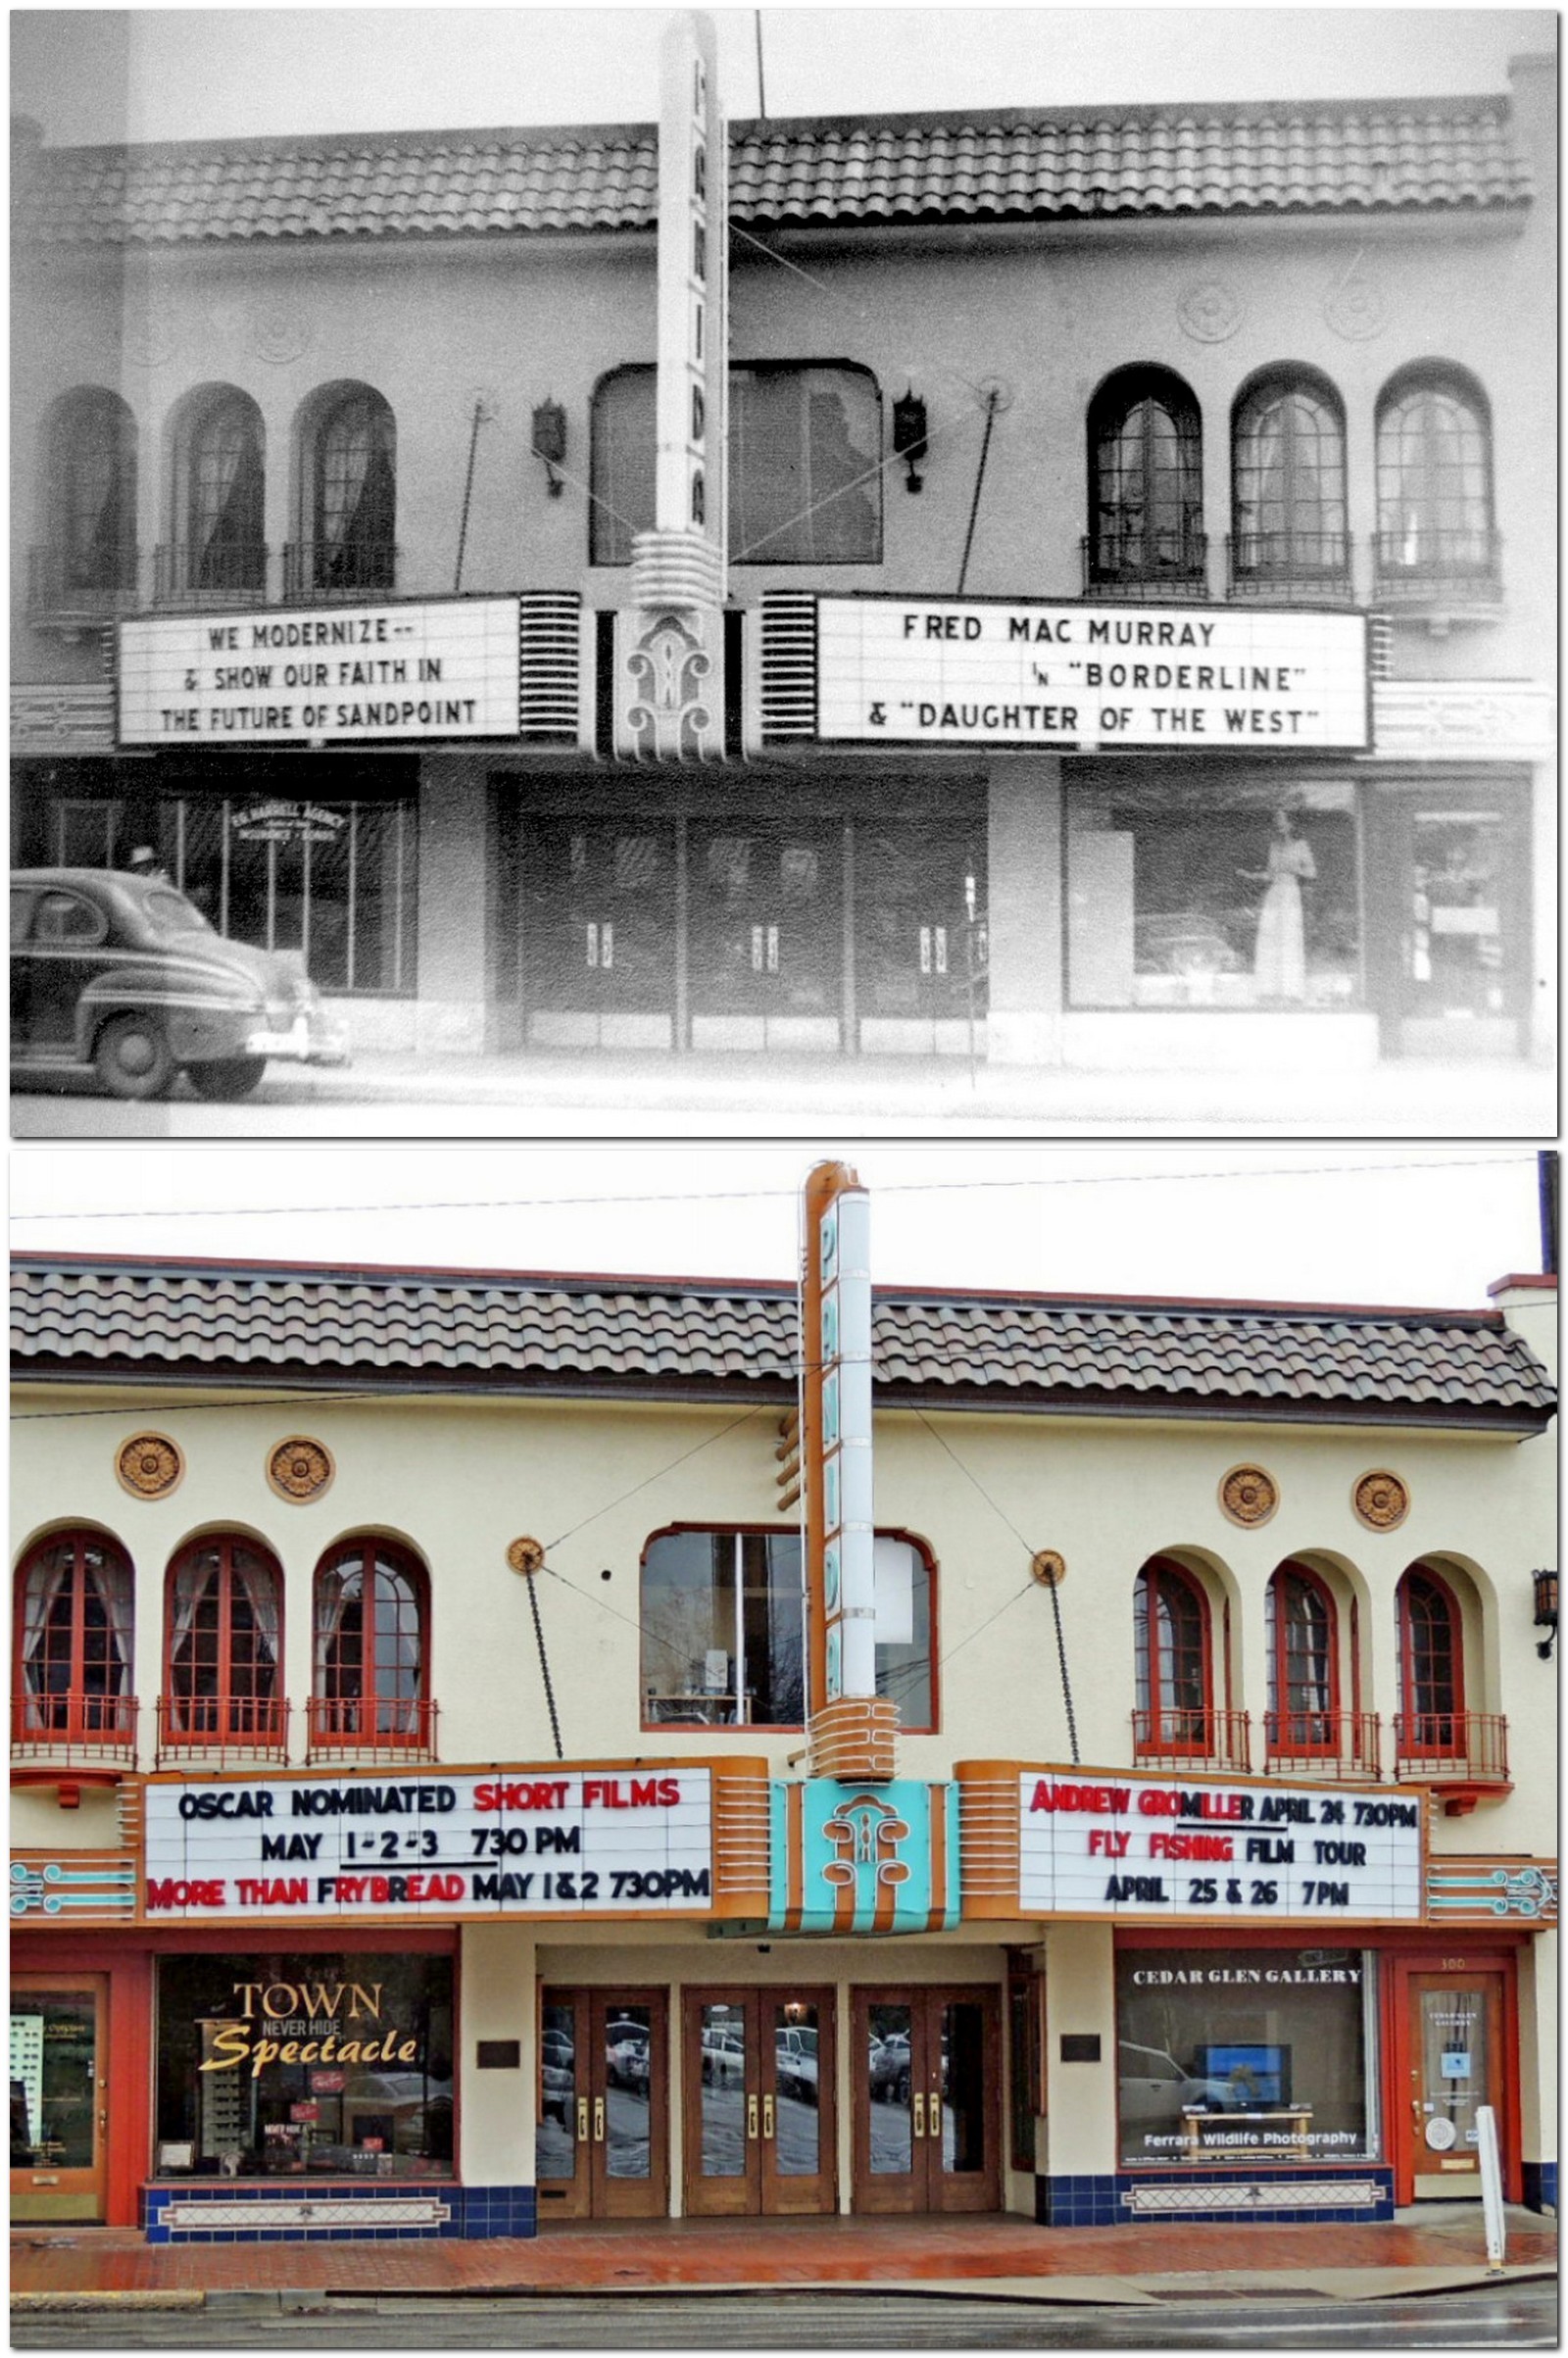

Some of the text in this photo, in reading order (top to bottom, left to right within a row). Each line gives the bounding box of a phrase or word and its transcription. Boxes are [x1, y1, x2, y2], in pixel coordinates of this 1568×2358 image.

[209, 626, 238, 650] WE
[904, 614, 1215, 648] FRED MAC MURRAY
[183, 659, 441, 691] & SHOW OUR FAITH IN
[161, 700, 476, 732] THE FUTURE OF SANDPOINT
[869, 702, 887, 726] &
[1100, 707, 1132, 731] OF
[1152, 709, 1205, 733] THE
[178, 1778, 680, 1820] OSCAR NOMINATED SHORT FILMS
[1030, 1780, 1131, 1815] ANDREW
[1138, 1790, 1253, 1820] GROMILLER
[1259, 1796, 1316, 1824] APRIL
[262, 1833, 323, 1861] MAY
[471, 1828, 527, 1856] 730
[535, 1825, 581, 1854] PM
[1088, 1830, 1367, 1866] FLY FISHING FILM TOUR
[145, 1878, 225, 1911] MORE
[234, 1876, 308, 1905] THAN
[318, 1873, 466, 1904] FRYBREAD
[472, 1872, 534, 1901] MAY
[1104, 1875, 1170, 1902] APRIL
[1189, 1878, 1217, 1904] 25
[1226, 1879, 1242, 1904] &
[1250, 1880, 1278, 1906] 26
[1133, 1969, 1362, 1985] CEDAR GLEN GALLERY
[233, 1983, 382, 2019] TOWN
[263, 2019, 341, 2037] NEVER HIDE
[198, 2025, 417, 2078] Spectacle
[1144, 2131, 1357, 2148] Ferrara Wildlife Photography
